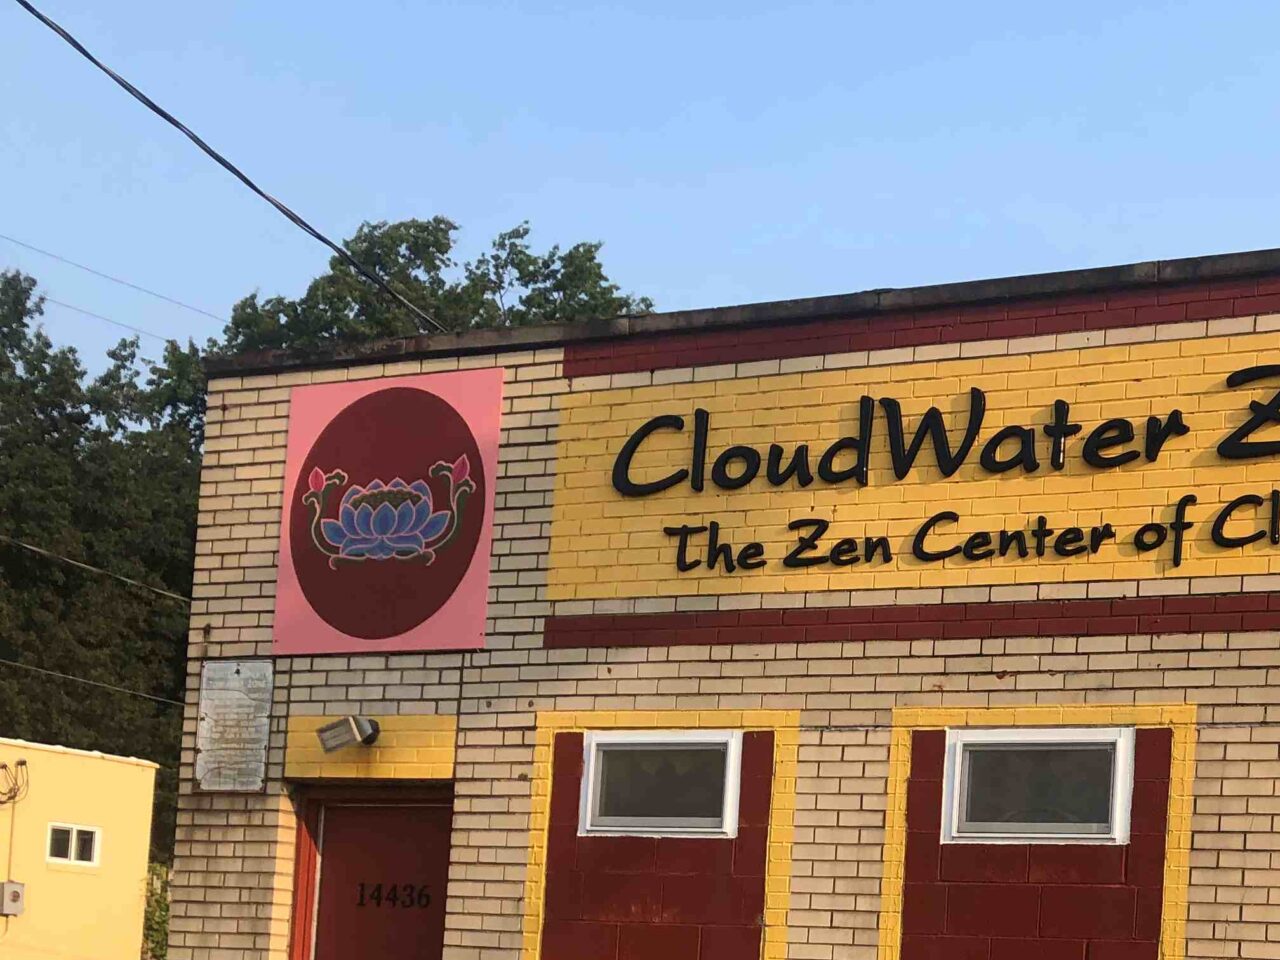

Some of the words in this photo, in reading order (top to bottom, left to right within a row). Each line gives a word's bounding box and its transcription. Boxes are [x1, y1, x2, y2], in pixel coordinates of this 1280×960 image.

[611, 386, 1190, 498] CloudWater
[663, 519, 767, 573] The
[782, 518, 893, 568] Zen
[912, 511, 1116, 563] Center
[1133, 494, 1197, 567] of
[356, 882, 432, 909] 14436
